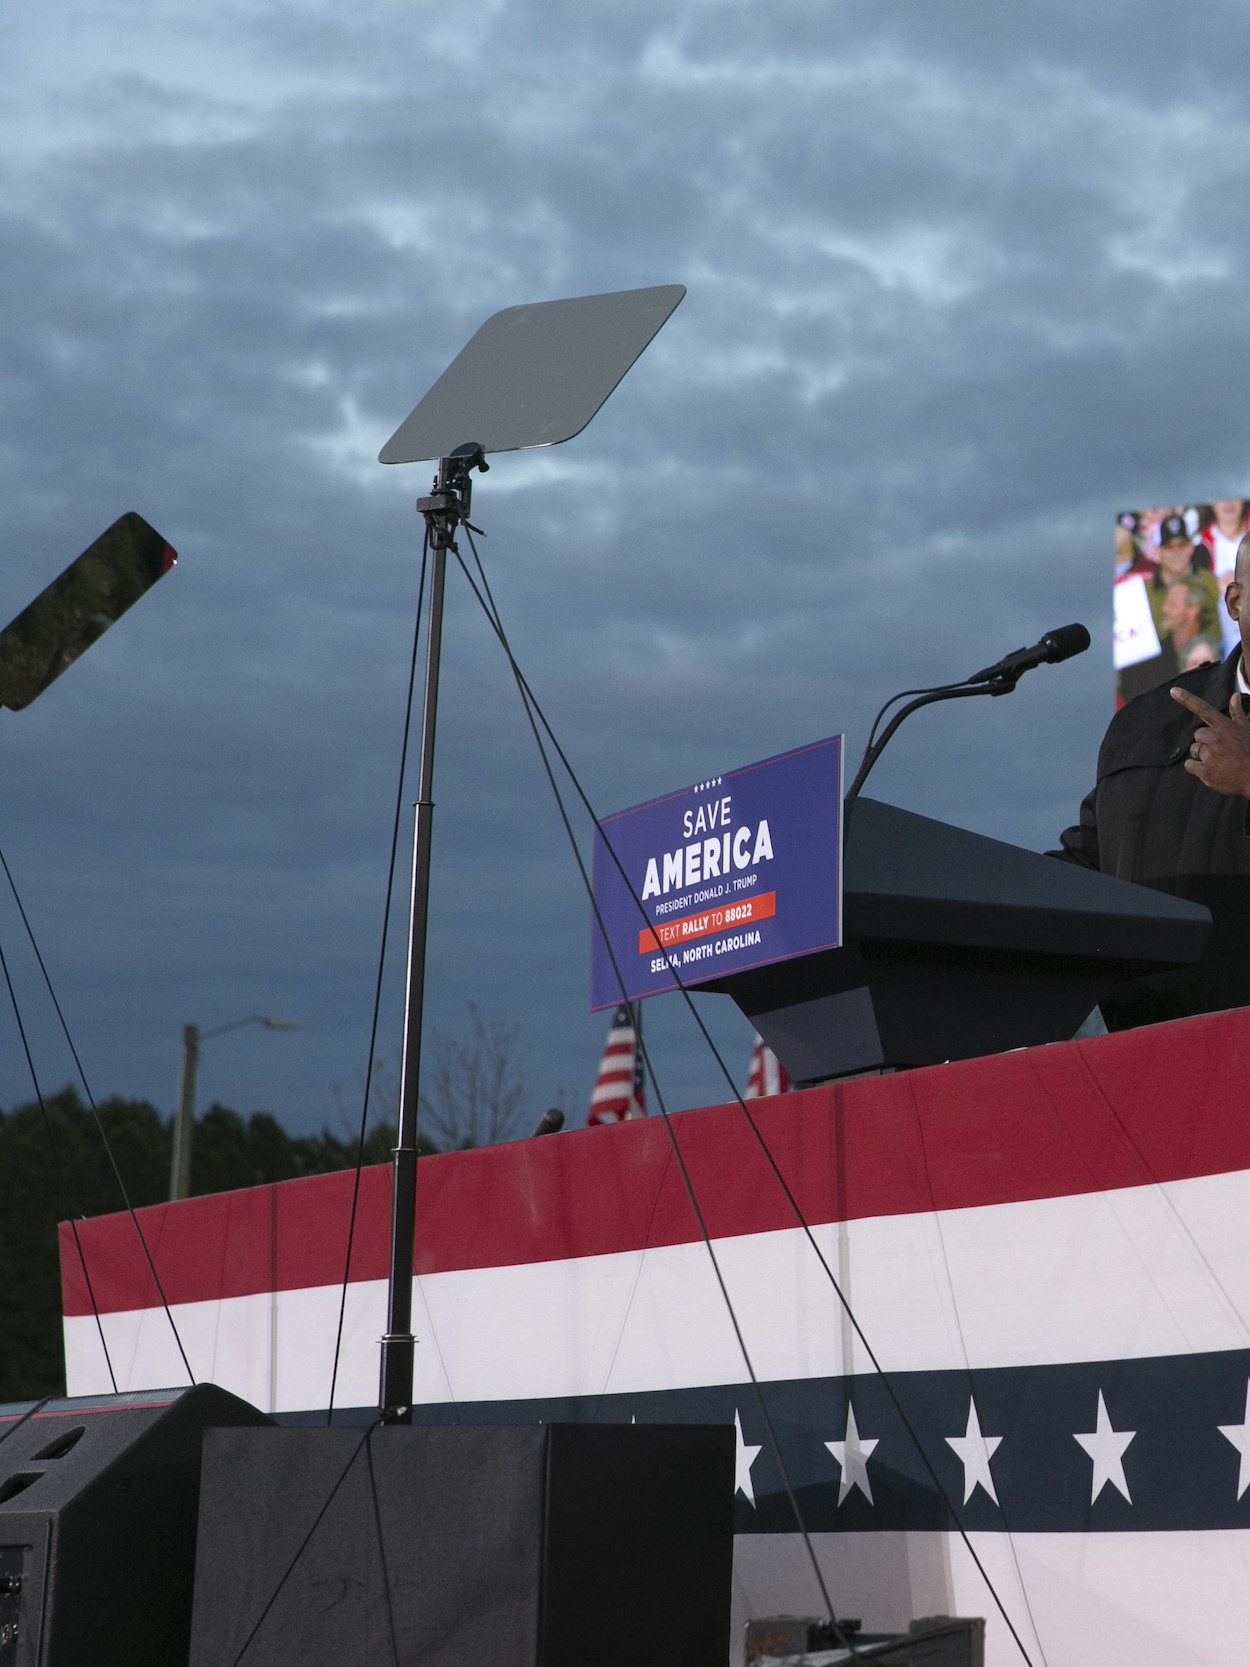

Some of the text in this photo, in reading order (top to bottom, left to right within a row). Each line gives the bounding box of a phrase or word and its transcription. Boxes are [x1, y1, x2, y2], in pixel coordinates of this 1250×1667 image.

[683, 796, 732, 839] SAVE
[642, 819, 774, 901] AMERICA
[655, 874, 758, 916] PRESIDENT DONALD J. TRUMP
[660, 903, 752, 942] TEXT RALLY TO 88022
[683, 944, 713, 964] NORTH
[715, 930, 761, 955] CAROLINA
